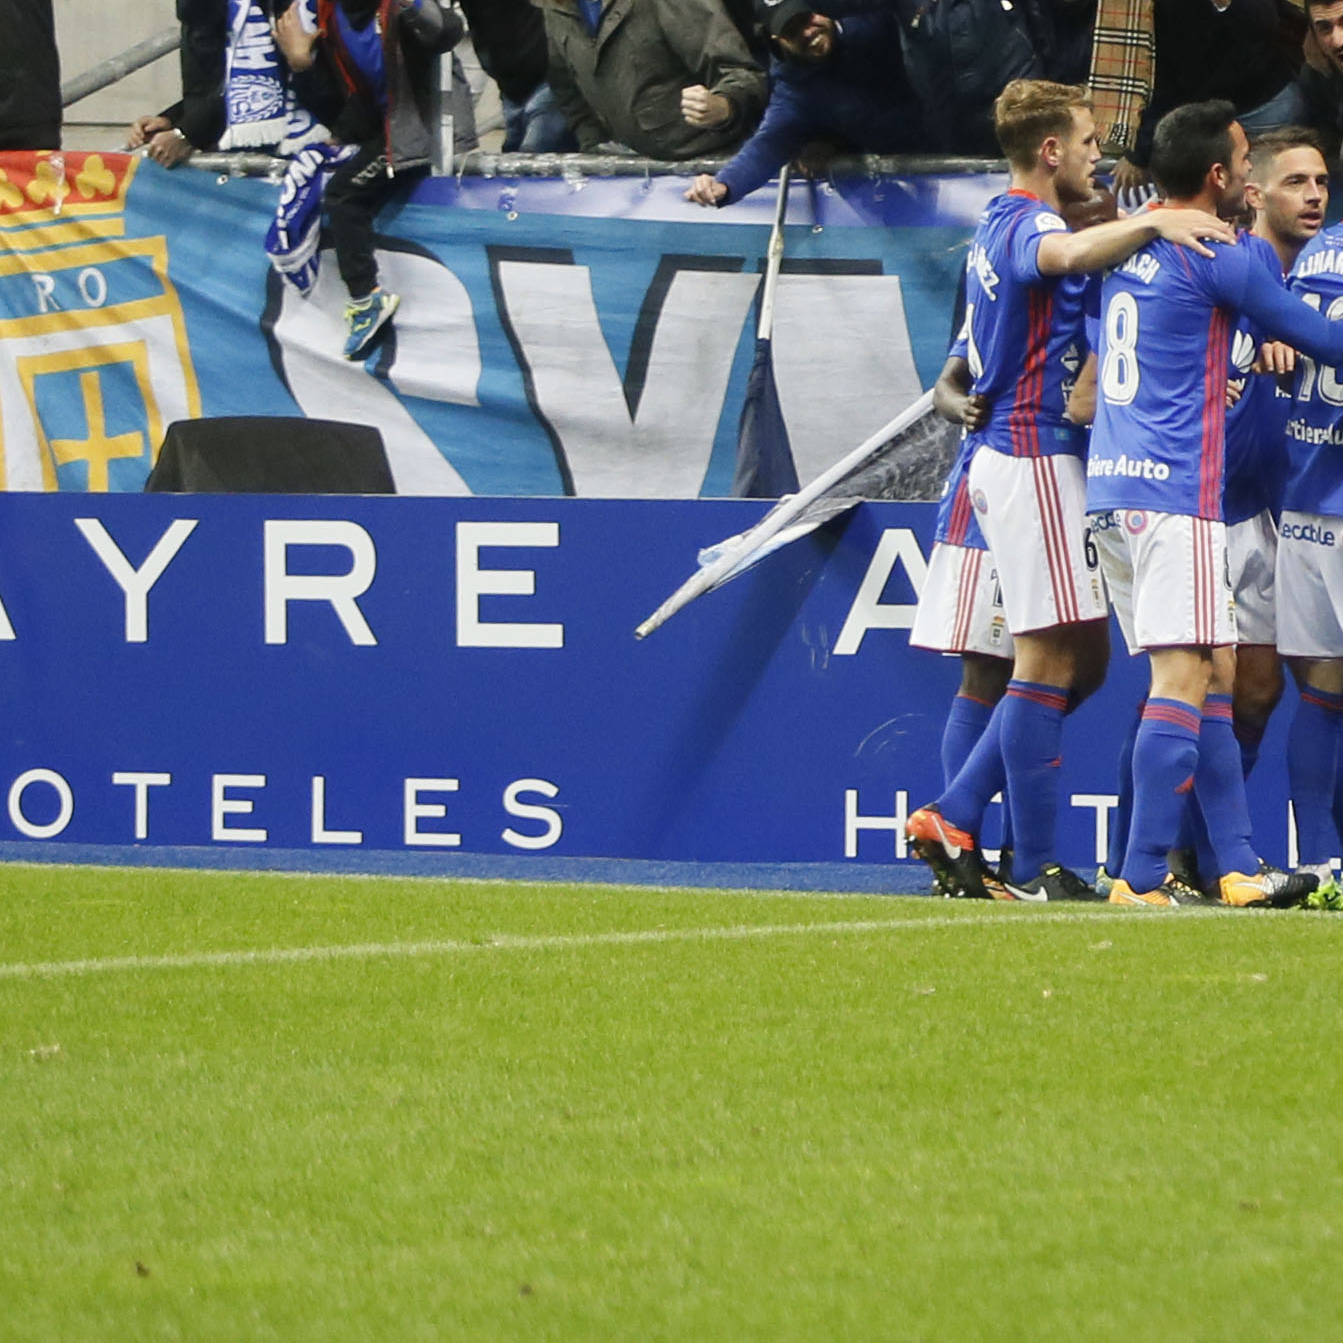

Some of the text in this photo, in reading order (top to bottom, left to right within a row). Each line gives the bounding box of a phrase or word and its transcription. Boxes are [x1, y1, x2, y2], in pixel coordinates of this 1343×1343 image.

[1102, 291, 1140, 406] 8
[1114, 454, 1170, 481] Auto
[0, 517, 564, 649] YRE
